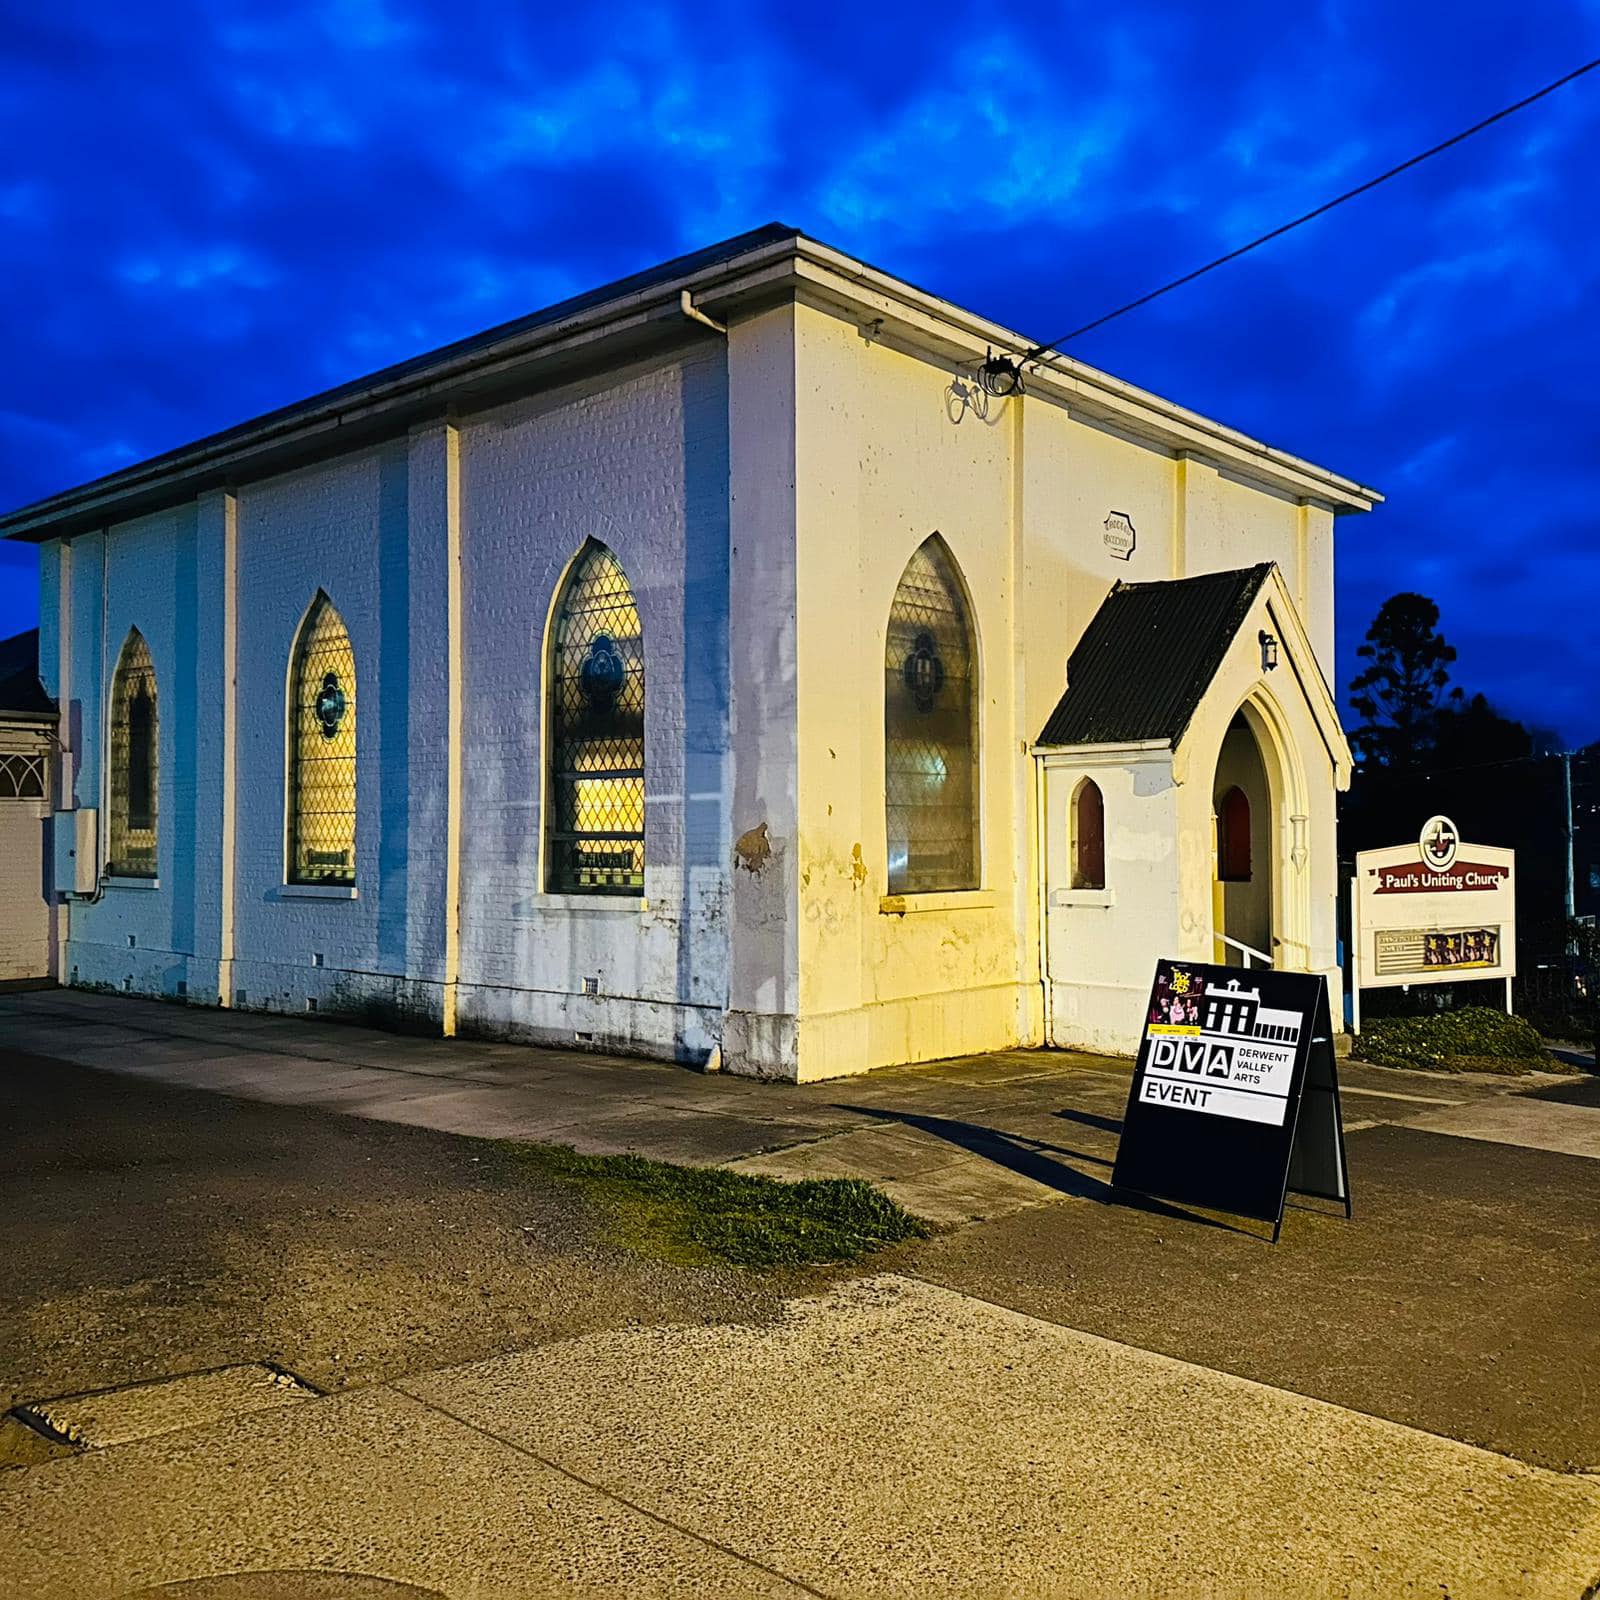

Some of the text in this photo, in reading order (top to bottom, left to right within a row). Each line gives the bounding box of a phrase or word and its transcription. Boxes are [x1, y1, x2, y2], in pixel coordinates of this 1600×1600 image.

[1385, 873, 1419, 888] Paul's
[1421, 872, 1464, 890] Uniting
[1465, 871, 1504, 886] Church
[1153, 1041, 1231, 1077] DVA
[1239, 1048, 1289, 1063] DERWENT
[1237, 1060, 1274, 1073] VALLEY
[1233, 1073, 1261, 1085] ARTS
[1145, 1082, 1212, 1108] EVENT
